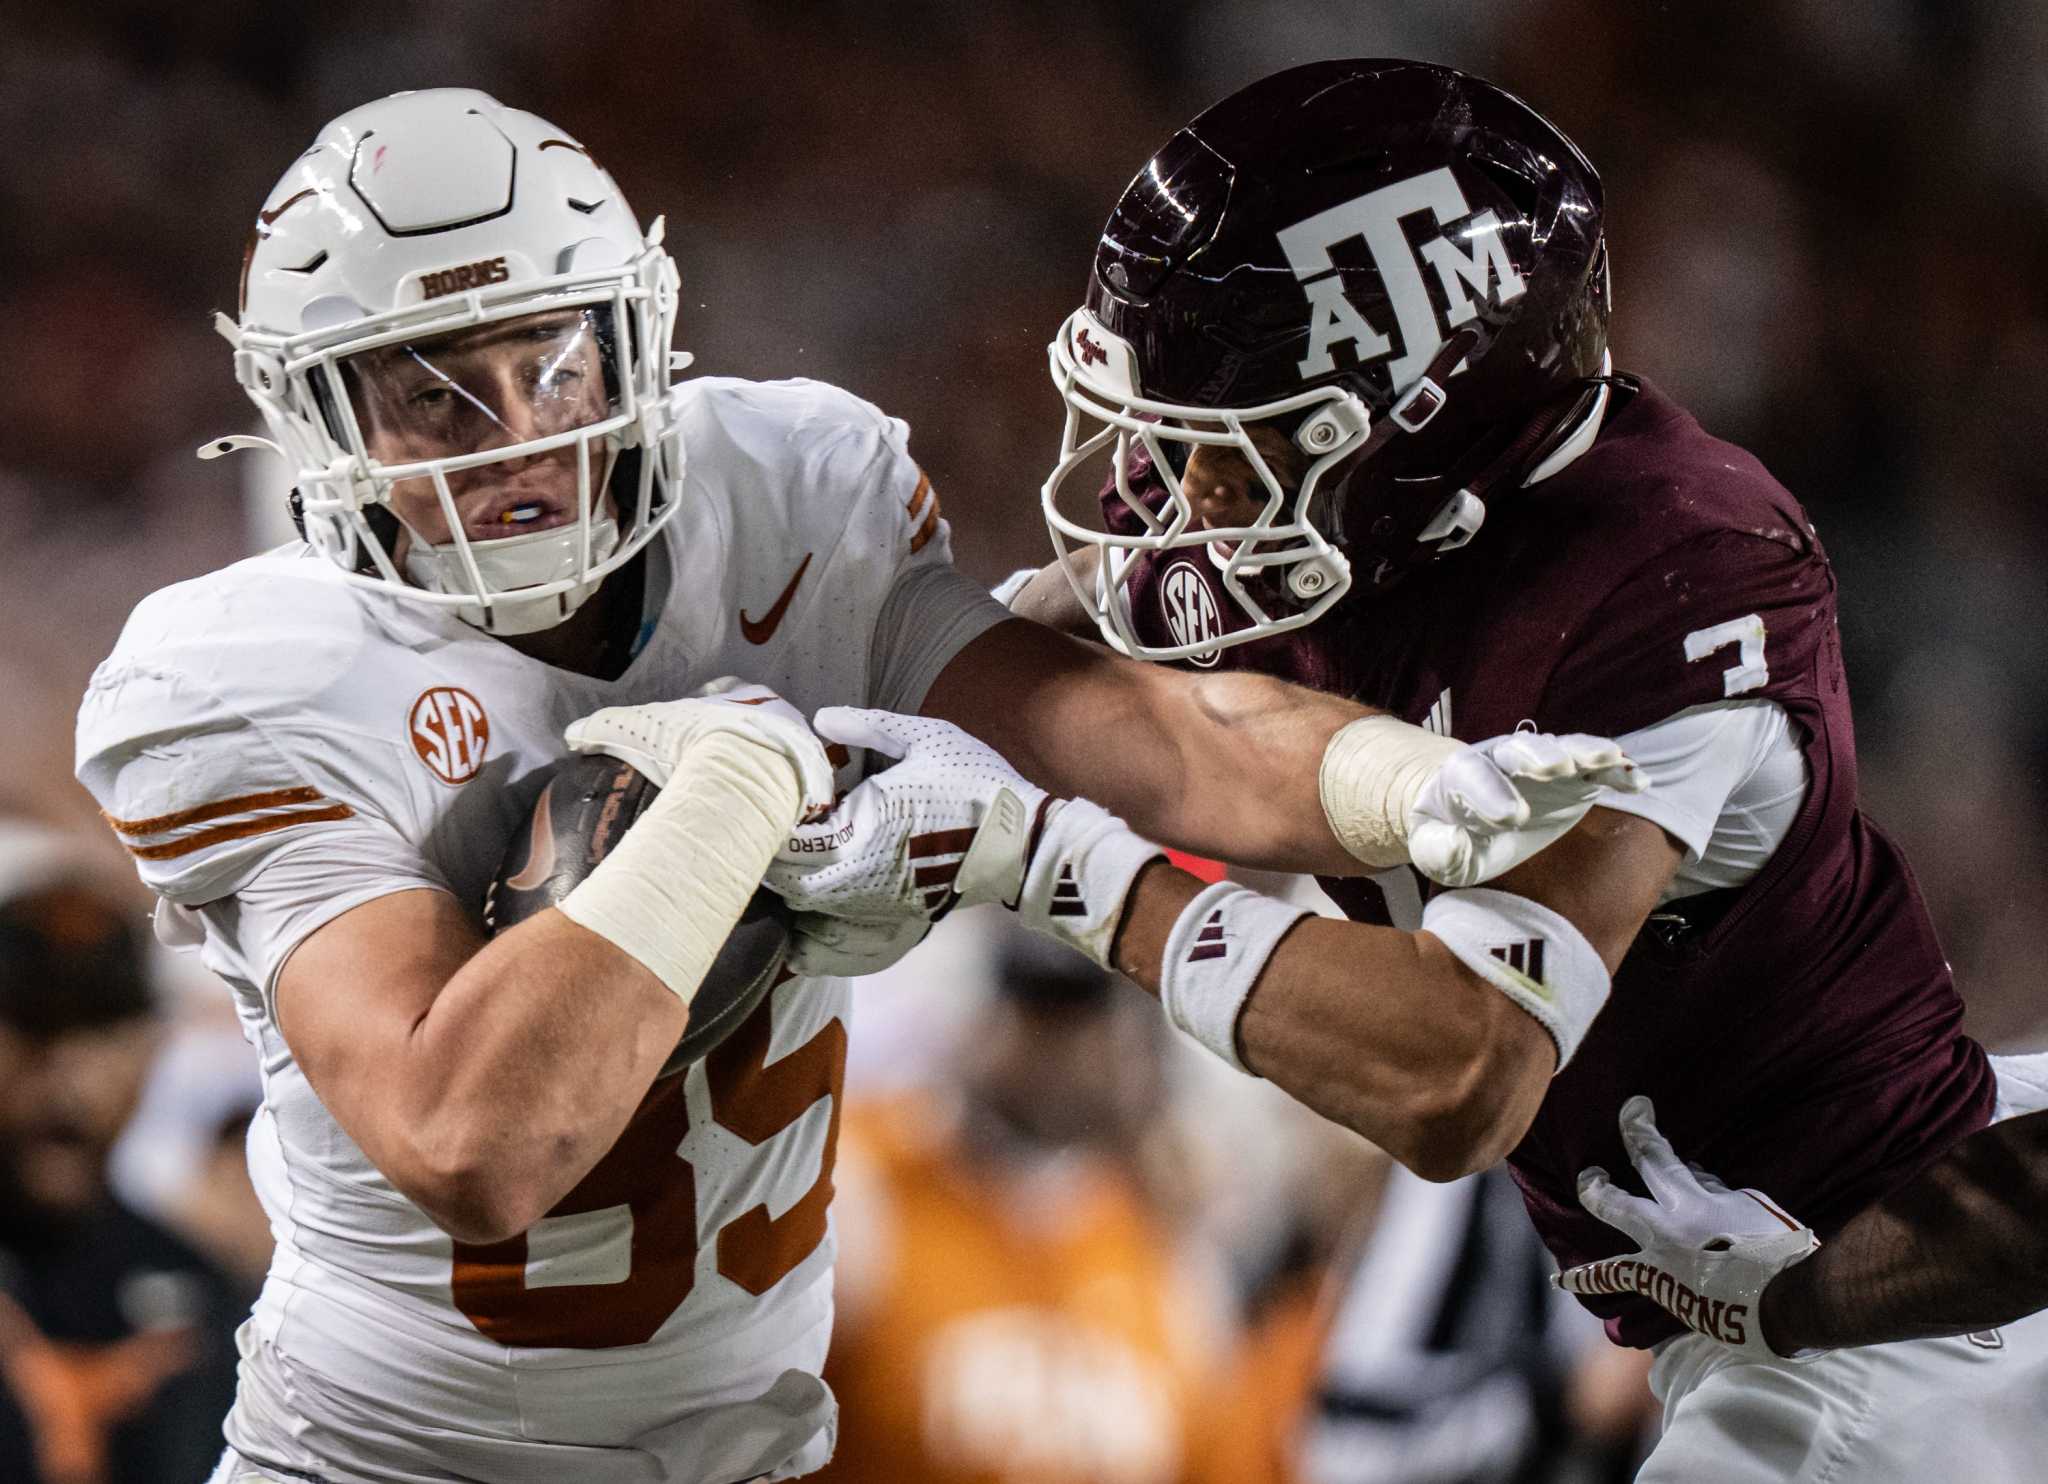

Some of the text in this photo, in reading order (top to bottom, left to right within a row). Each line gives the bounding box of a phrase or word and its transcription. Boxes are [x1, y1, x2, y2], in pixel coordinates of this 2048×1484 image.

[420, 256, 509, 300] HORNS
[1166, 571, 1215, 659] SEC
[414, 690, 485, 779] SEC
[789, 820, 855, 853] ADIZERO
